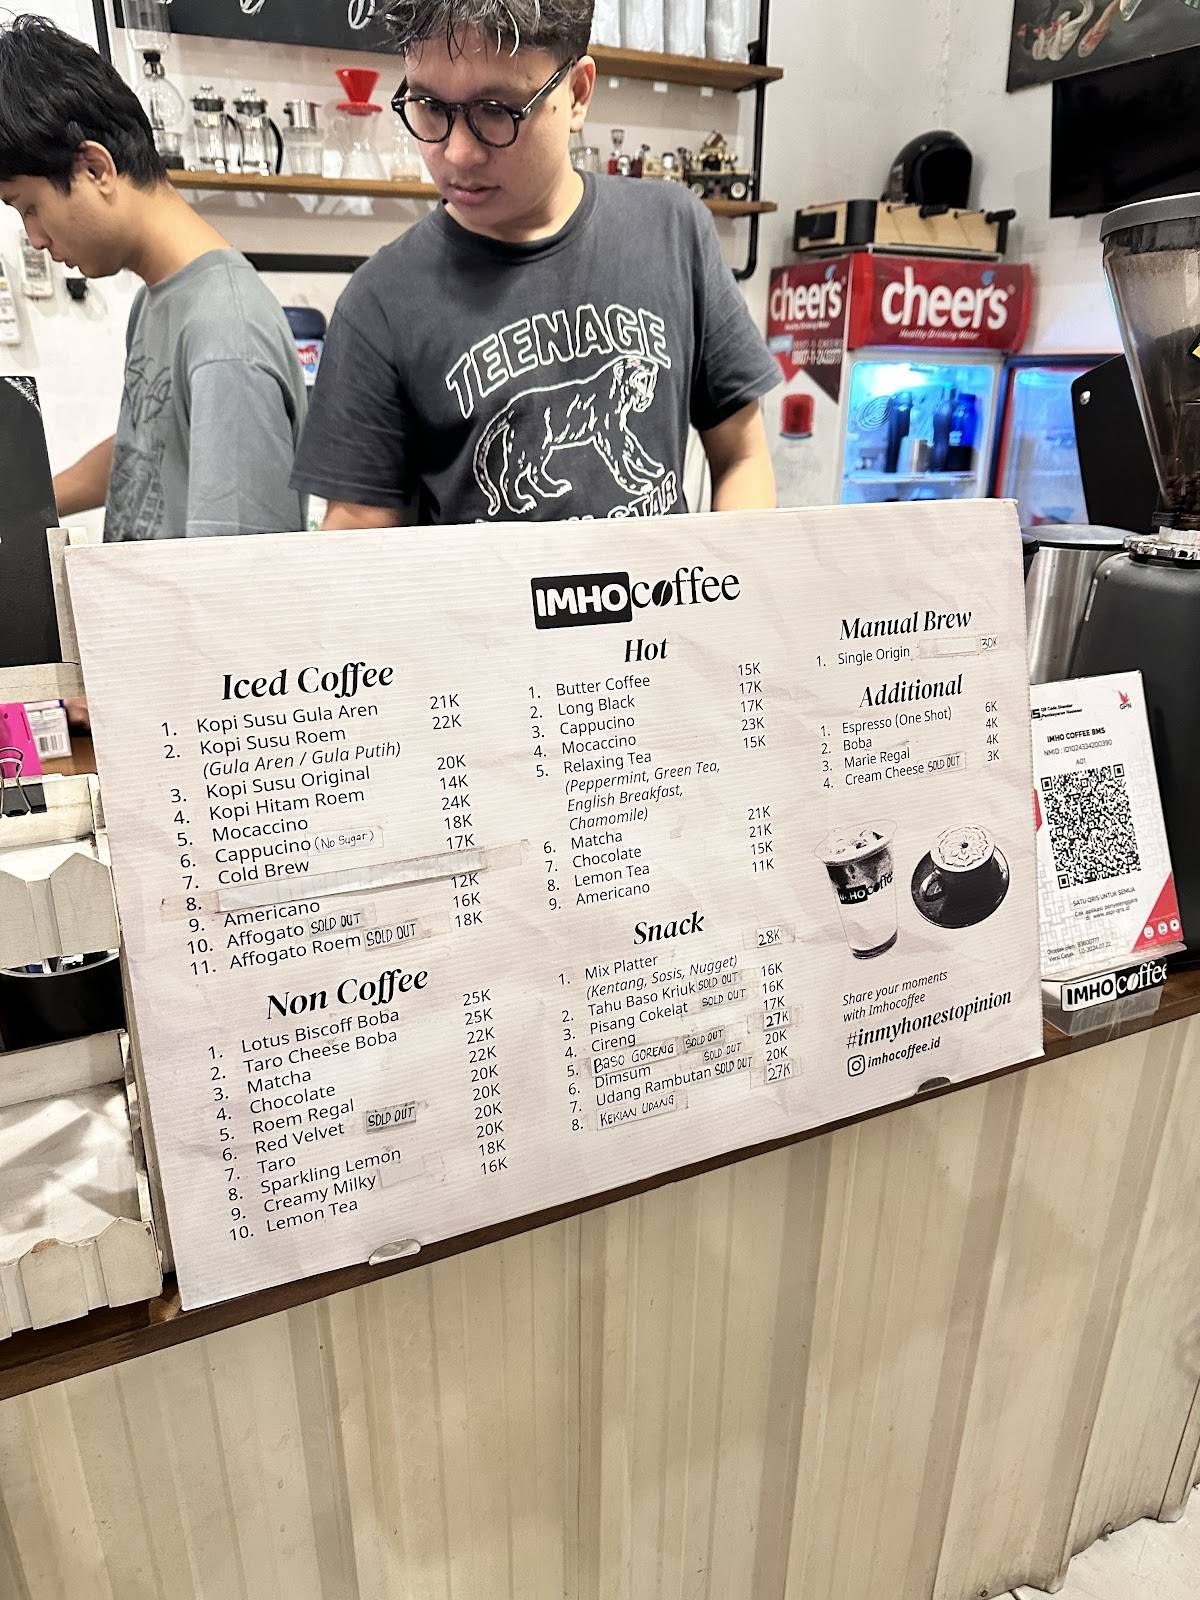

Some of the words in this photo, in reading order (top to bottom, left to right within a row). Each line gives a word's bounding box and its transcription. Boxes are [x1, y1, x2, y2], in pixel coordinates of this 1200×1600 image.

[445, 304, 671, 419] TEENAGE
[839, 611, 919, 641] Manual
[923, 610, 972, 632] Brew
[624, 638, 668, 663] Hot
[838, 650, 873, 666] Single
[875, 645, 910, 662] Origin
[221, 668, 289, 701] Iced
[297, 661, 394, 699] Coffee
[556, 682, 602, 697] Butter
[605, 674, 650, 691] Coffee
[859, 673, 963, 708] Additional
[558, 702, 594, 717] Long
[598, 694, 635, 712] Black
[197, 715, 238, 735] Kopi
[243, 713, 287, 729] Susu
[292, 707, 333, 723] Gula
[338, 705, 378, 719] Aren
[560, 716, 635, 737] Cappucino
[842, 718, 892, 736] Espresso
[895, 713, 922, 729] (One
[924, 706, 952, 722] Shot)
[200, 737, 241, 757] Kopi
[246, 735, 290, 750] Susu
[295, 729, 346, 745] Roem
[562, 735, 637, 755] Mocaccino
[843, 737, 872, 752] Boba
[1047, 733, 1064, 742] IMHO
[1066, 729, 1090, 740] COFFEE
[203, 758, 249, 780] (Gula
[254, 756, 294, 772] Aren
[312, 747, 349, 765] Gula
[355, 741, 401, 760] Putih)
[563, 755, 624, 774] Relaxing
[627, 752, 652, 765] Tea
[844, 753, 877, 769] Marie
[880, 747, 910, 764] Regal
[928, 760, 944, 772] SOLD
[947, 755, 960, 768] OUT
[206, 780, 247, 800] Kopi
[252, 778, 296, 794] Susu
[301, 765, 370, 788] Original
[565, 771, 650, 796] (Peppermint,
[654, 766, 692, 780] Green
[696, 761, 720, 774] Tea,
[845, 771, 882, 786] Cream
[885, 764, 925, 779] Cheese
[209, 801, 250, 822] Kopi
[256, 798, 310, 815] Hitam
[315, 790, 365, 807] Roem
[568, 792, 615, 813] English
[619, 785, 683, 804] Breakfast,
[212, 818, 308, 842] Mocaccino
[569, 806, 648, 831] Chamomile)
[215, 839, 311, 865] Cappucino
[571, 831, 623, 850] Matcha
[572, 848, 642, 868] Chocolate
[218, 865, 259, 885] Cold
[264, 861, 310, 878] Brew
[574, 870, 623, 887] Lemon
[625, 865, 650, 878] Tea
[576, 883, 650, 906] Americano
[223, 902, 320, 928] Americano
[310, 917, 336, 934] SOLD
[340, 912, 361, 927] OUT
[633, 910, 705, 945] Snack
[226, 925, 304, 949] Affogato
[366, 929, 393, 947] SOLD
[397, 923, 417, 939] OUT
[758, 929, 780, 946] 28K
[229, 946, 307, 970] Affogato
[312, 936, 361, 954] Roem
[585, 965, 610, 980] Mix
[614, 955, 658, 974] Platter
[586, 977, 647, 1001] (Kentang,
[651, 969, 685, 985] Sosis,
[689, 955, 738, 976] Nugget)
[698, 977, 718, 991] SOLD
[721, 971, 739, 985] OUT
[842, 990, 873, 1007] Share
[874, 983, 900, 1002] your
[901, 971, 948, 991] moments
[1067, 979, 1113, 1005] IMHO
[266, 990, 329, 1020] Non
[337, 968, 428, 1007] Coffee
[587, 1000, 622, 1017] Tahu
[626, 992, 658, 1008] Baso
[662, 981, 696, 1000] Kriuk
[702, 994, 724, 1007] SOLD
[727, 988, 747, 1001] OUT
[590, 1016, 635, 1035] Pisang
[639, 1002, 689, 1023] Cokelat
[766, 1010, 789, 1028] 27K
[843, 1006, 866, 1023] with
[868, 992, 926, 1017] Imhocoffee
[241, 1034, 290, 1054] Lotus
[295, 1016, 353, 1043] Biscoff
[357, 1010, 399, 1029] Boba
[846, 991, 1012, 1050] #inmyhonestopinion
[591, 1033, 636, 1053] Cireng
[685, 1034, 705, 1049] SOLD
[707, 1029, 724, 1043] OUT
[242, 1056, 283, 1073] Taro
[288, 1039, 350, 1064] Cheese
[355, 1031, 397, 1050] Boba
[703, 1049, 723, 1062] SOLD
[726, 1042, 742, 1055] OUT
[867, 1036, 941, 1068] imhocoffee.id
[595, 1065, 651, 1089] Dimsum
[714, 1061, 735, 1076] SOLD
[737, 1056, 752, 1071] OUT
[767, 1063, 791, 1081] 27K
[247, 1070, 312, 1095] Matcha
[596, 1087, 641, 1107] Udang
[645, 1067, 712, 1094] Rambutan
[250, 1086, 336, 1114] Chocolate
[252, 1114, 303, 1135] Roem
[308, 1098, 354, 1122] Regal
[368, 1111, 391, 1127] SOLD
[394, 1106, 415, 1122] OUT
[255, 1134, 288, 1155] Red
[292, 1122, 345, 1145] Velvet
[256, 1156, 296, 1174] Taro
[260, 1165, 340, 1196] Sparkling
[345, 1149, 401, 1173] Lemon
[263, 1187, 329, 1213] Creamy
[333, 1175, 376, 1196] Milky
[266, 1209, 325, 1233] Lemon
[328, 1200, 358, 1216] Tea
